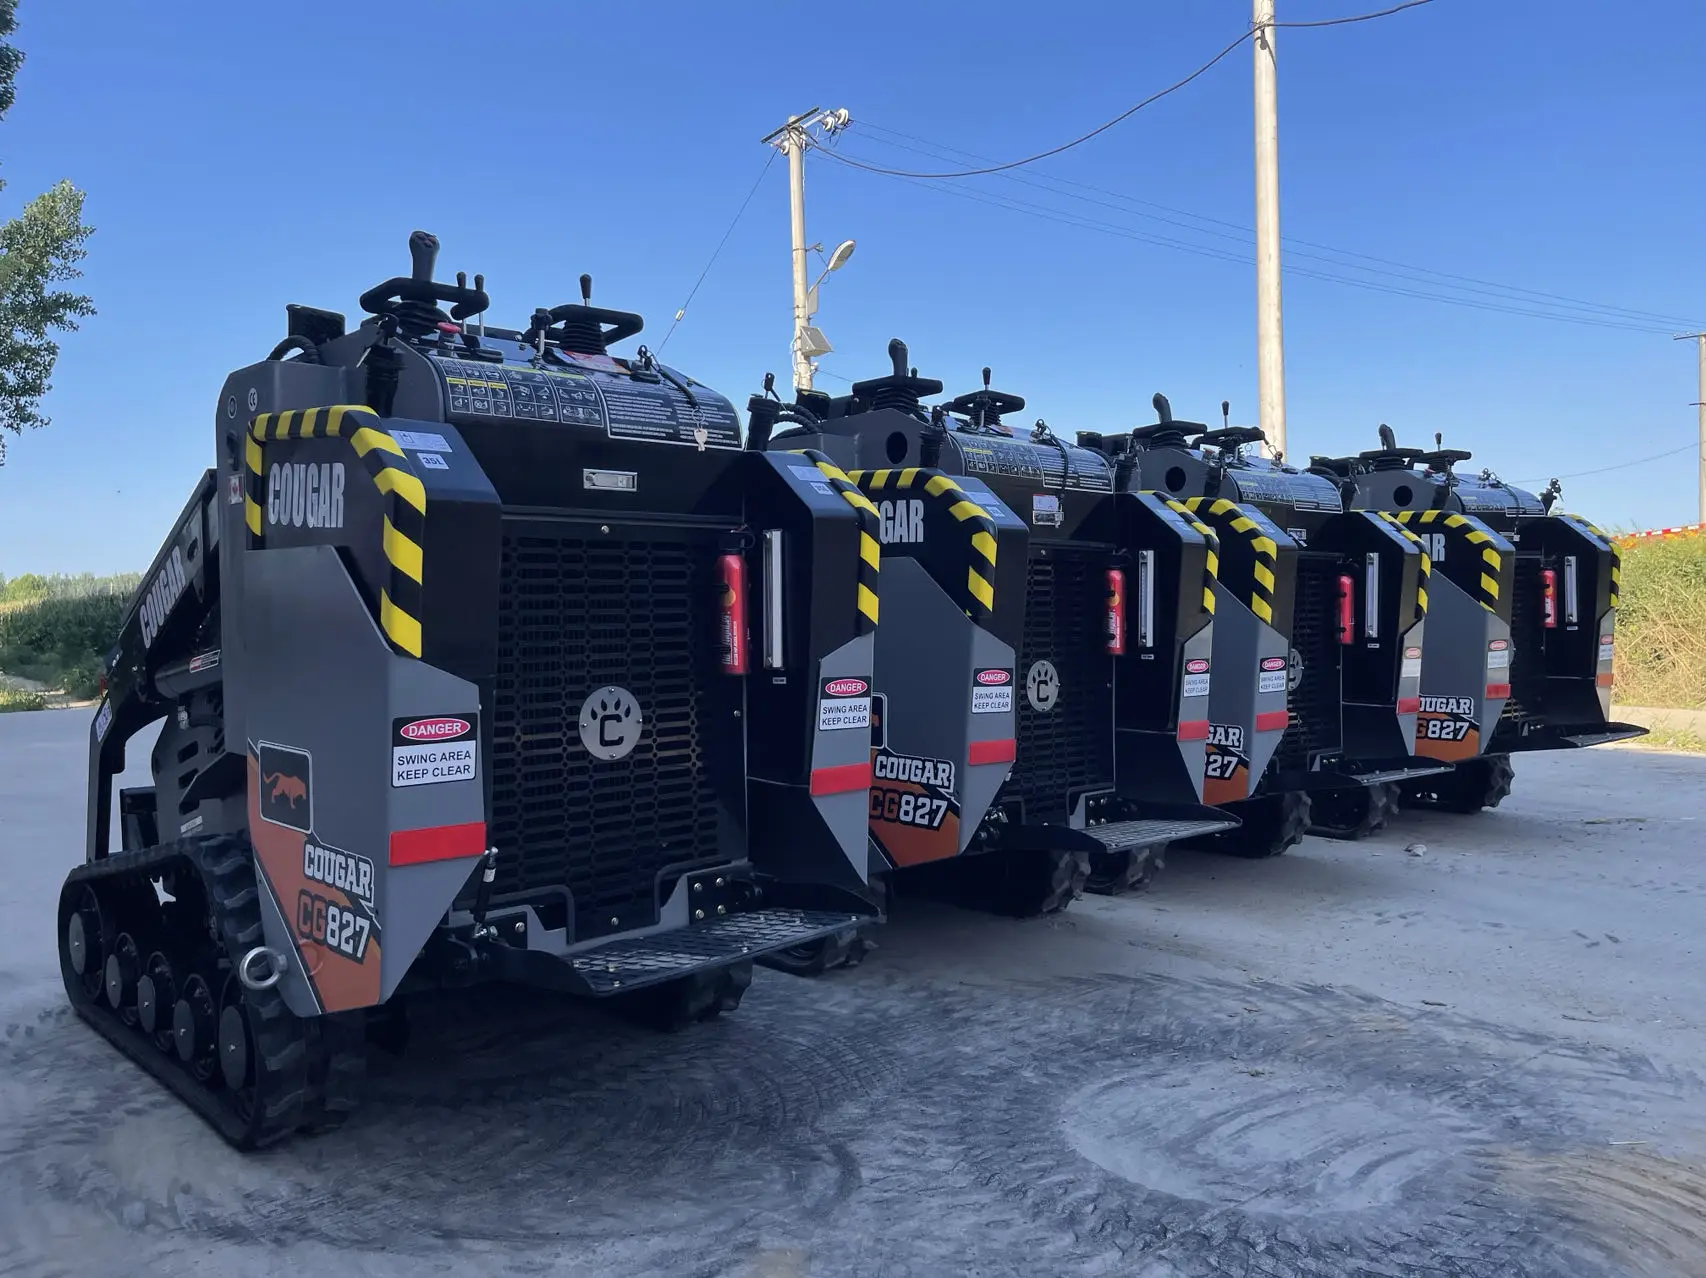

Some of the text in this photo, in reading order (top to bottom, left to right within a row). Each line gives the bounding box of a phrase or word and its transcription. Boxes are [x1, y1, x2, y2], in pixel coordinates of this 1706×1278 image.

[423, 457, 444, 465] 35L
[268, 462, 345, 528] COUGAR
[871, 499, 924, 544] GAR
[139, 545, 186, 648] COUGAR
[830, 683, 862, 692] DANGER
[980, 673, 1007, 681] DANGER
[1037, 680, 1049, 702] C
[822, 704, 868, 714] SWING AREA
[990, 701, 1009, 709] CLEAR
[1419, 697, 1471, 713] UGAR
[408, 722, 462, 737] DANGER
[600, 714, 625, 747] C
[822, 715, 867, 726] KEEP CLEAR
[1416, 719, 1470, 740] G827
[1206, 726, 1240, 747] GAR
[397, 750, 472, 766] SWING AREA
[397, 764, 471, 781] KEEP CLEAR
[875, 755, 951, 787] COUGAR
[869, 789, 948, 827] CG827
[304, 843, 371, 898] COUGAR
[299, 894, 370, 958] CG827
